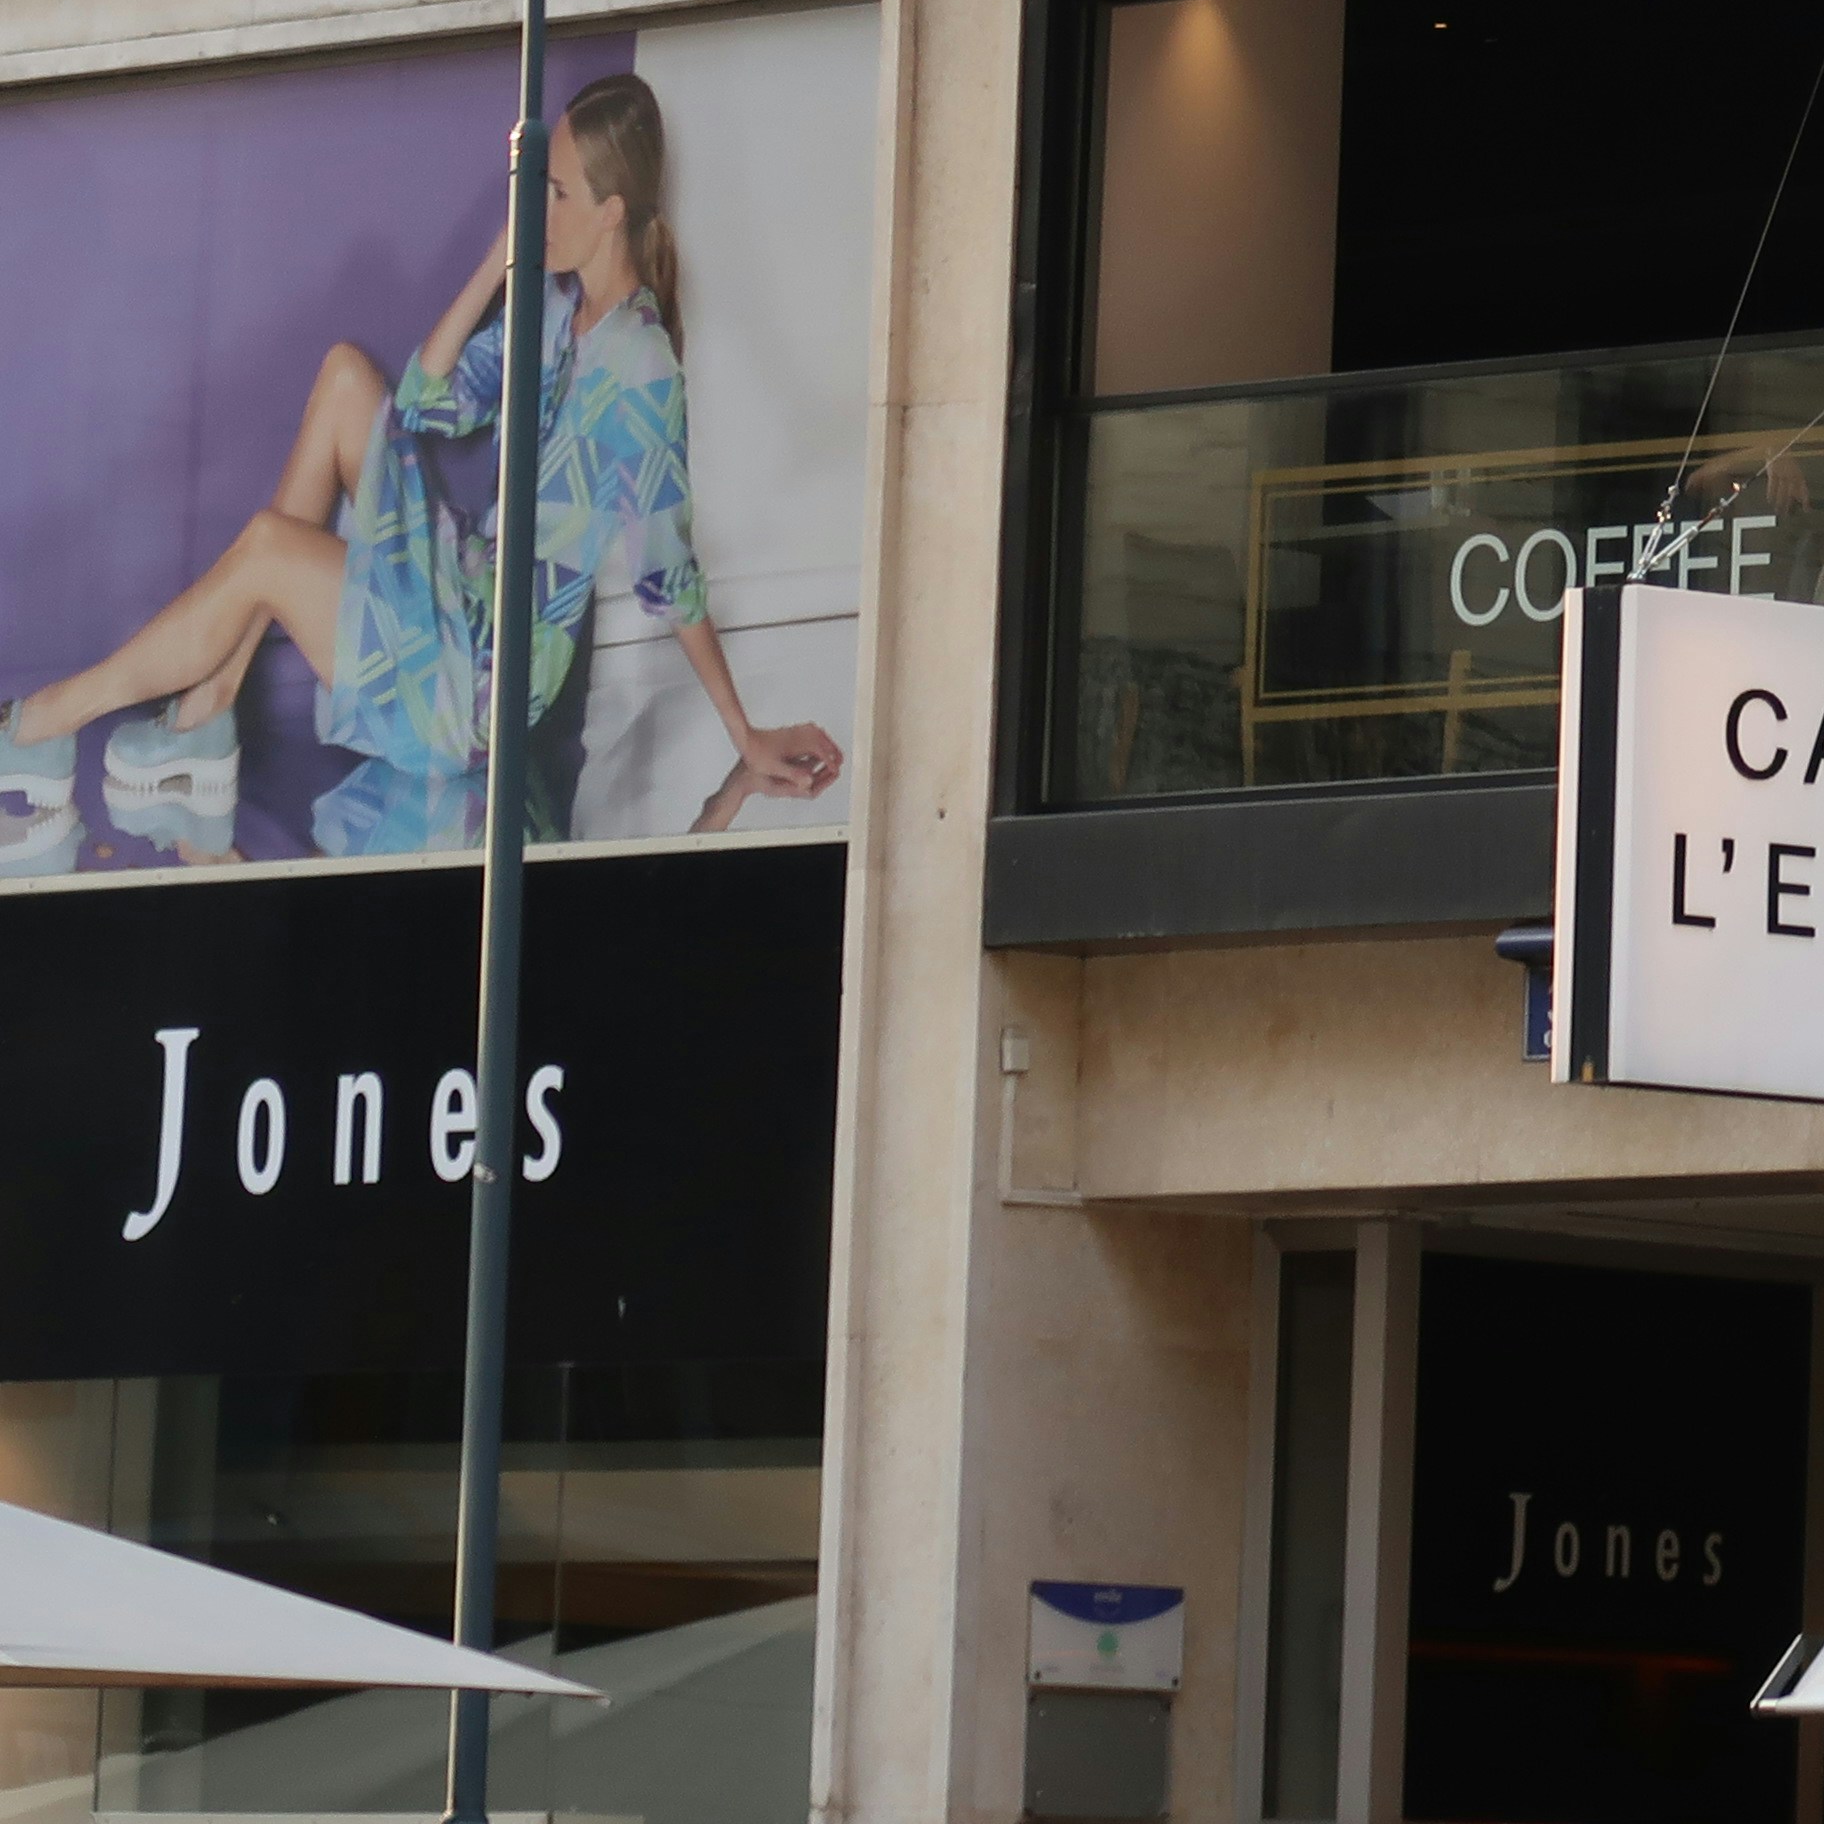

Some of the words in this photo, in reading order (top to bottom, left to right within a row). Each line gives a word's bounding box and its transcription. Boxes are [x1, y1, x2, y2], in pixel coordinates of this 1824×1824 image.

[1450, 515, 1776, 626] COFFEE
[122, 1027, 565, 1242] Jones
[1493, 1492, 1724, 1591] Jones
